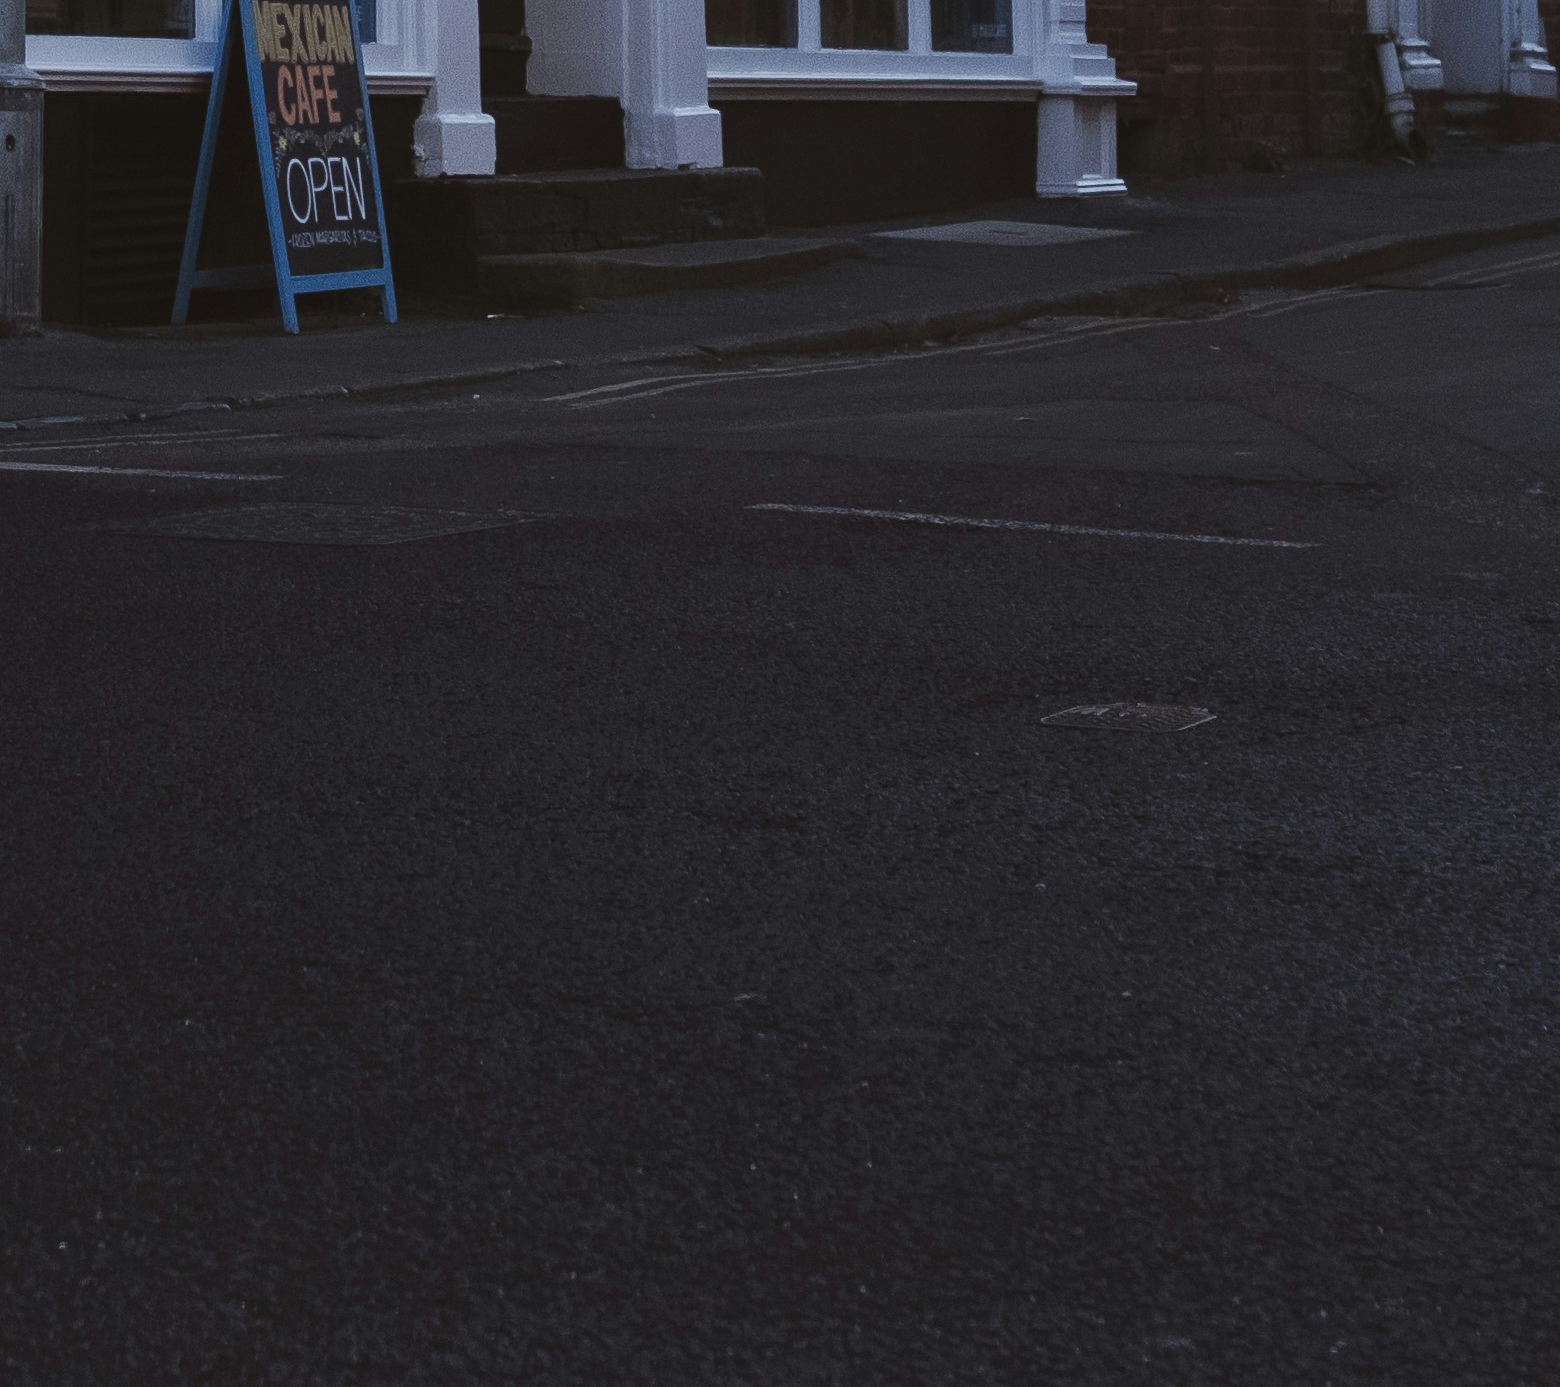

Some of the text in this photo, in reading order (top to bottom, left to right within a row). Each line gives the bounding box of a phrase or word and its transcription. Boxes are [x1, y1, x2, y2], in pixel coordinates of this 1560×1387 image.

[252, 0, 355, 65] MEXICAN
[277, 65, 342, 125] CAFE
[286, 156, 367, 224] OPEN
